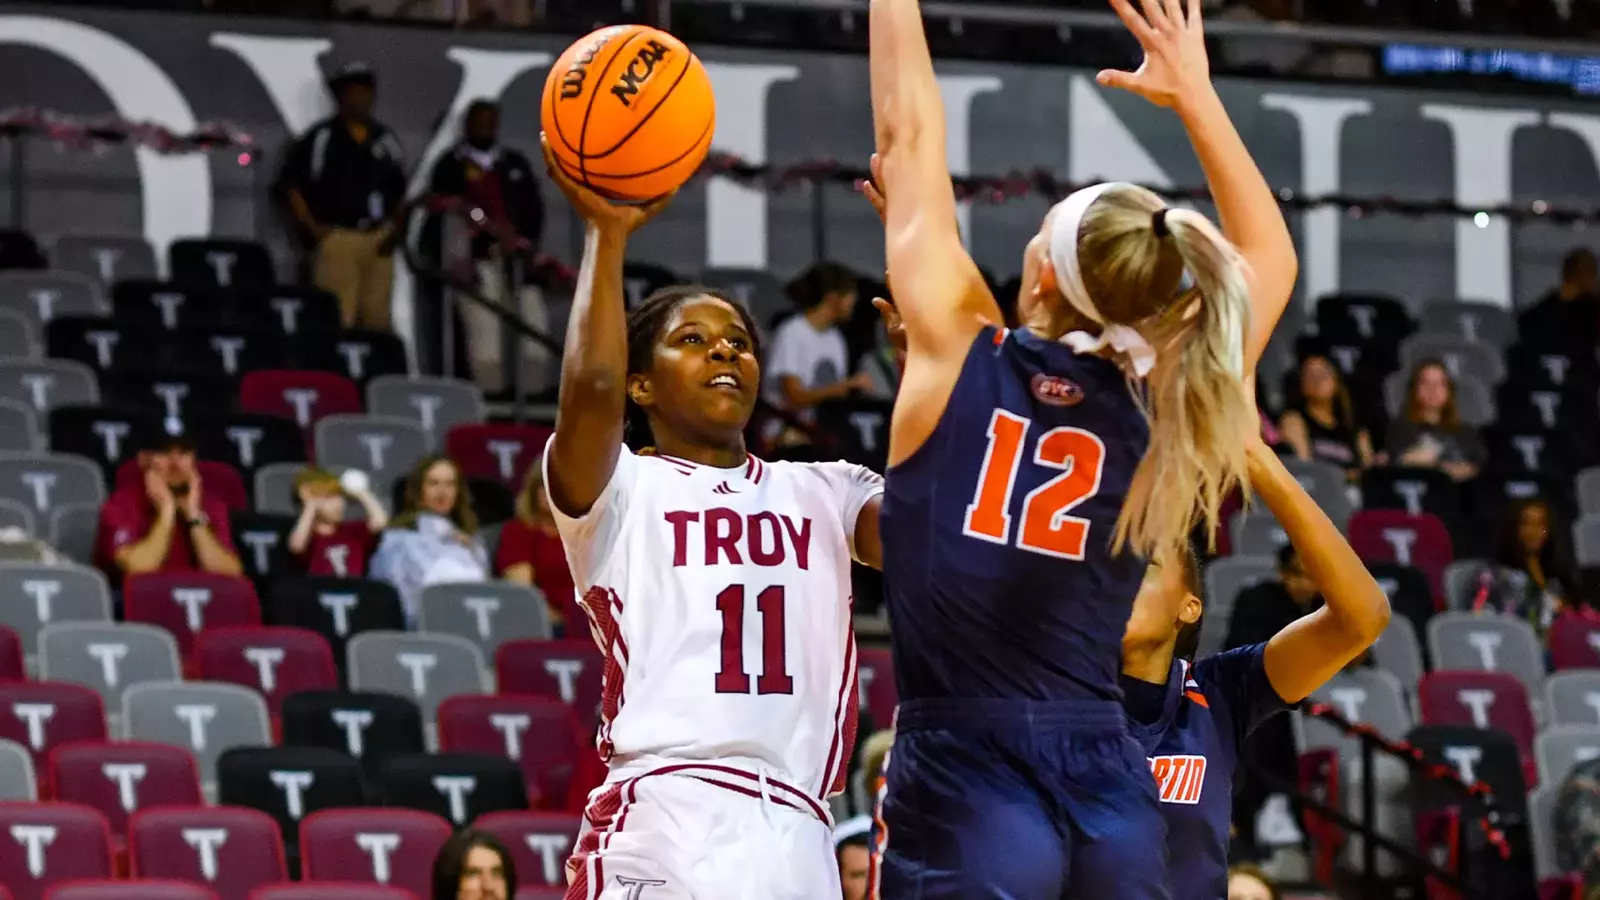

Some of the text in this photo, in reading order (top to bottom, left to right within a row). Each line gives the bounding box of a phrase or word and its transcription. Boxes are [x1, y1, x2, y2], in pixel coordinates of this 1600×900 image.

[611, 40, 671, 107] NCAA
[204, 251, 238, 287] T
[151, 292, 186, 330] T
[269, 297, 304, 335] T
[83, 331, 122, 370] T
[210, 336, 247, 375] T
[336, 341, 372, 379] T
[152, 382, 191, 417] T
[282, 388, 319, 427] T
[410, 395, 444, 430] T
[1530, 391, 1562, 428] T
[92, 421, 131, 462] T
[225, 426, 265, 468] T
[358, 433, 394, 470] T
[850, 411, 884, 450] T
[486, 440, 523, 480] T
[1512, 434, 1545, 471] T
[22, 471, 56, 511] T
[963, 408, 1106, 561] 12
[1393, 479, 1427, 516] T
[243, 531, 279, 575] T
[664, 507, 811, 570] TROY
[1382, 527, 1417, 566] T
[23, 581, 61, 623] T
[173, 588, 211, 632] T
[318, 593, 358, 636] T
[463, 598, 500, 638] T
[715, 583, 793, 695] 11
[1467, 631, 1502, 671] T
[88, 644, 127, 687] T
[244, 648, 285, 692] T
[397, 653, 437, 697] T
[544, 659, 583, 703] T
[1330, 688, 1366, 722] T
[1457, 689, 1496, 730] T
[14, 704, 55, 750] T
[176, 705, 216, 749] T
[331, 710, 373, 758] T
[489, 714, 531, 761] T
[1147, 755, 1206, 804] RTIN
[1442, 745, 1482, 785] T
[103, 764, 147, 813] T
[270, 771, 313, 819] T
[433, 775, 476, 826] T
[10, 825, 57, 878] T
[182, 828, 228, 881] T
[355, 833, 401, 884] T
[524, 834, 569, 885] T
